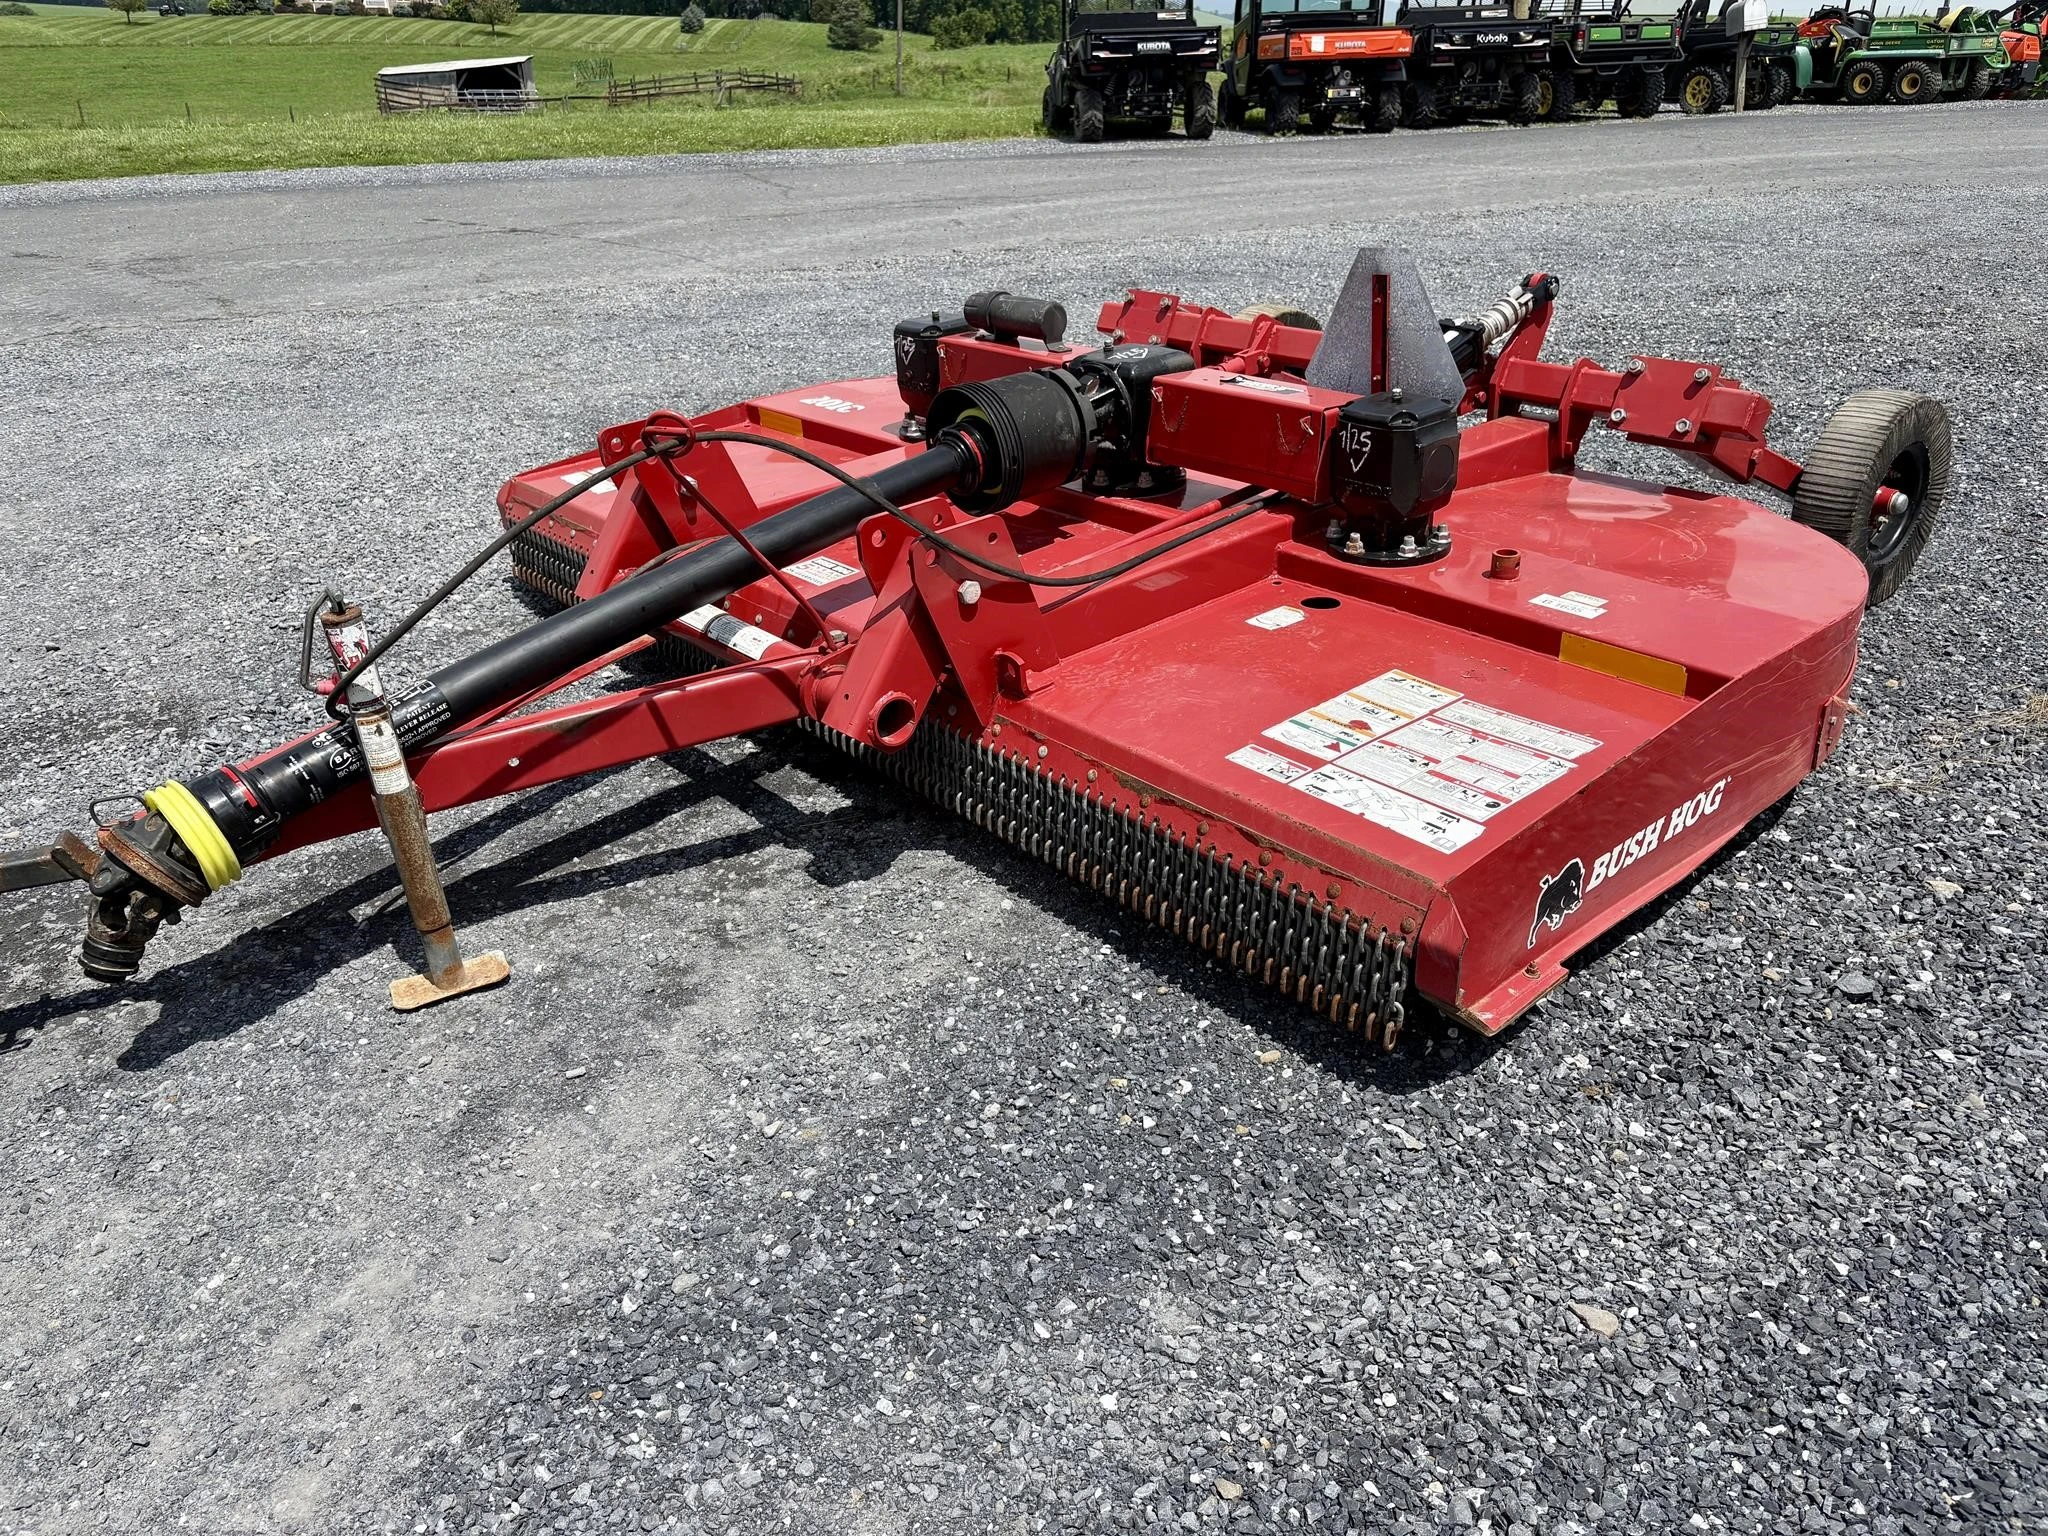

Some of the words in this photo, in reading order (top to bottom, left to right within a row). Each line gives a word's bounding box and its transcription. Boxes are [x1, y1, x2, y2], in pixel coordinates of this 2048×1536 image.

[1137, 41, 1171, 51] KUBOTA
[1335, 41, 1366, 49] KUBOTA
[1476, 33, 1508, 43] Kubota
[396, 719, 418, 734] LEVER
[418, 702, 448, 722] RELEASE
[406, 702, 431, 719] PATENT
[418, 711, 451, 733] APPROVED
[404, 726, 438, 747] APPROVED
[1585, 815, 1668, 893] BUSH
[1663, 778, 1726, 843] HOG
